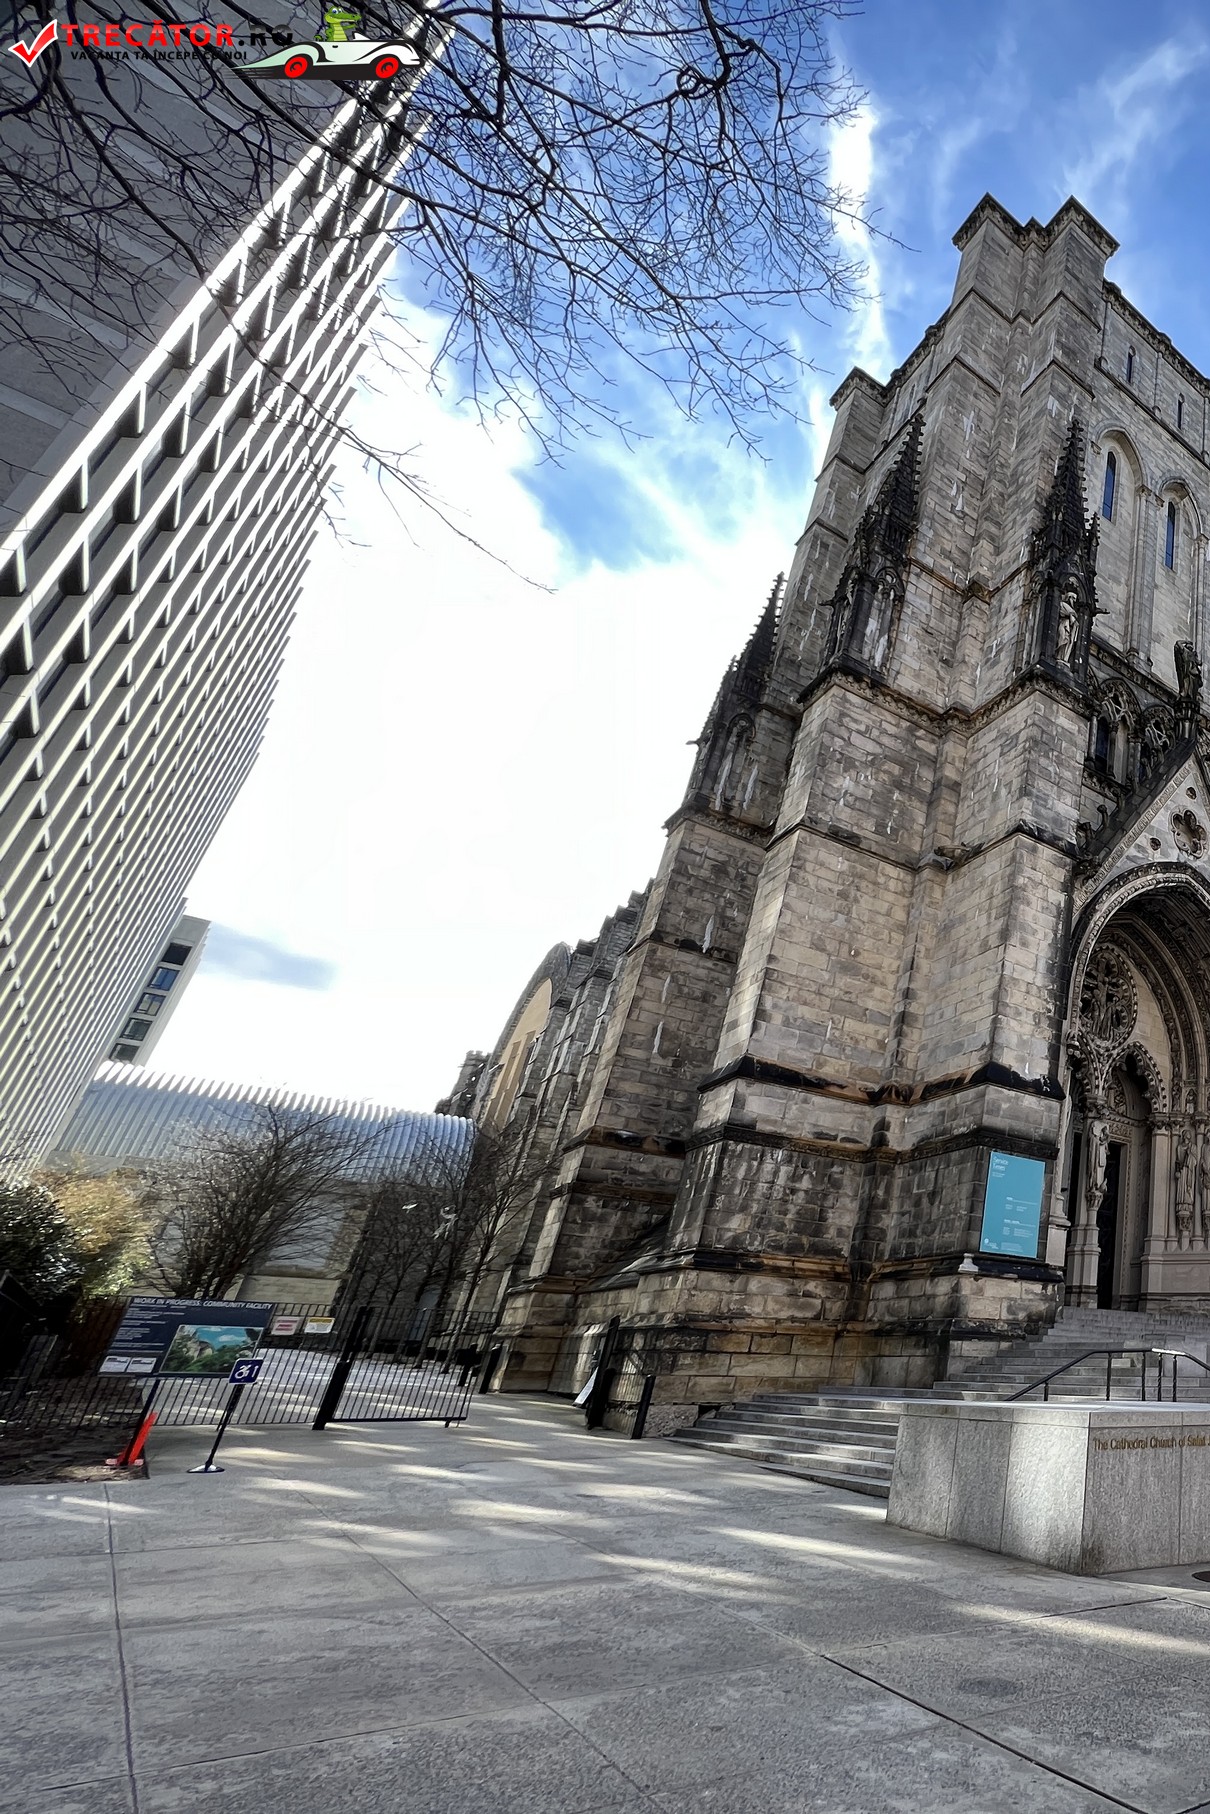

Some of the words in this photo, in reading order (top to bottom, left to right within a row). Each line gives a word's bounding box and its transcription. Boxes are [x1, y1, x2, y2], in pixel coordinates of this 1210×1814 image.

[246, 1302, 273, 1310] FACILITY
[1093, 1438, 1108, 1450] The
[1110, 1437, 1148, 1450] Cathedral
[1150, 1436, 1177, 1449] Church
[1178, 1435, 1186, 1447] of
[1187, 1435, 1206, 1447] Saint
